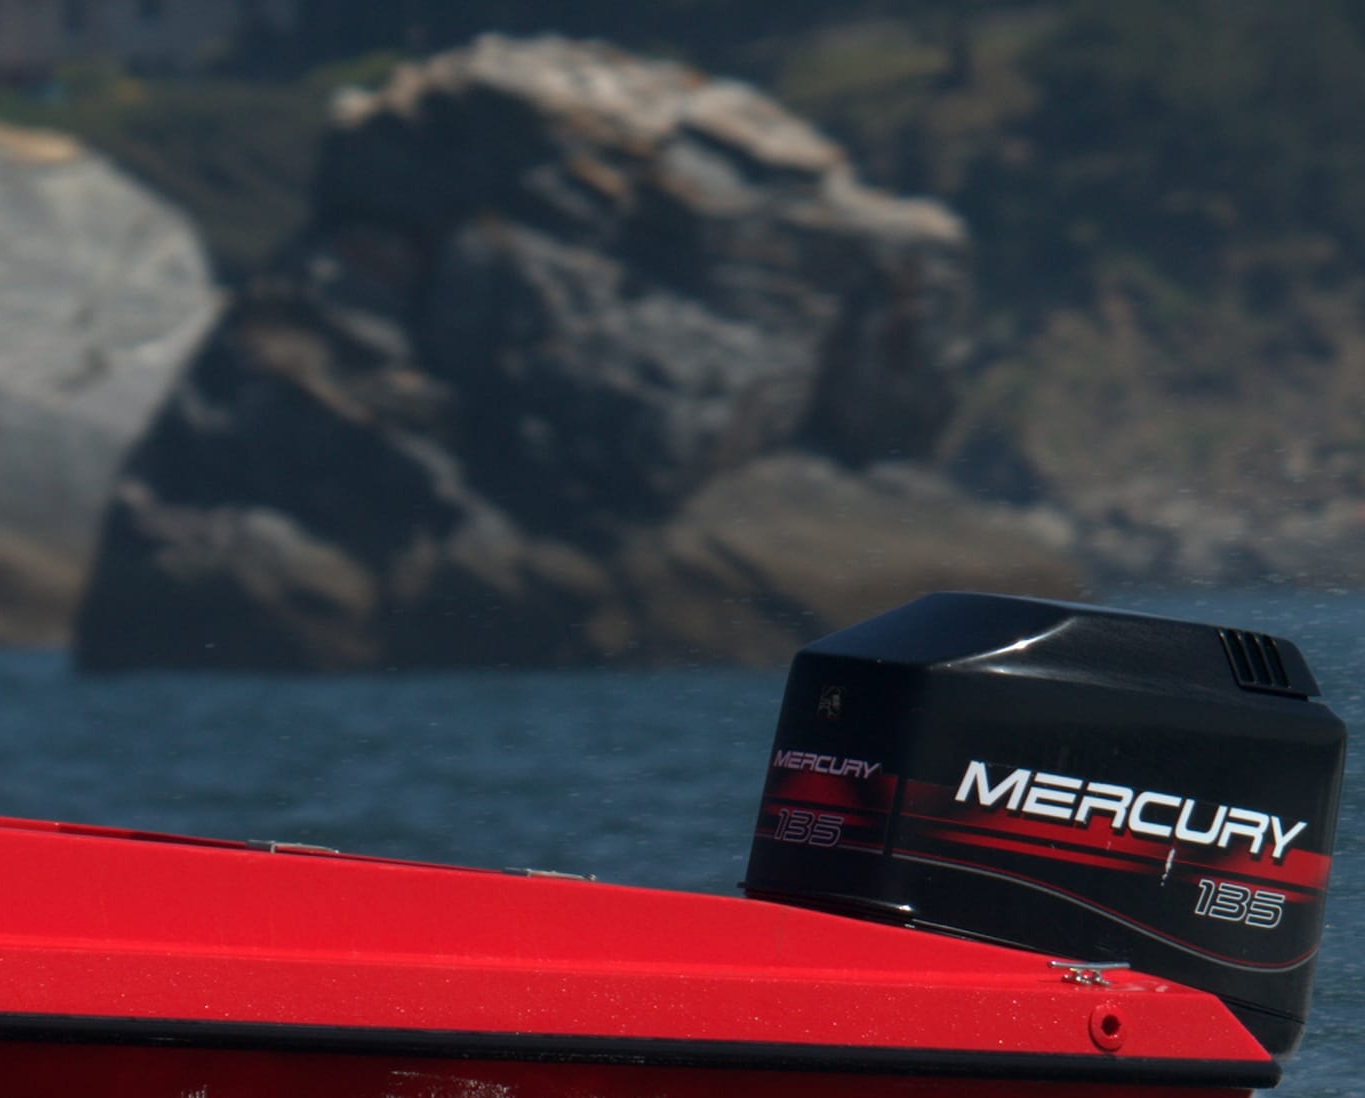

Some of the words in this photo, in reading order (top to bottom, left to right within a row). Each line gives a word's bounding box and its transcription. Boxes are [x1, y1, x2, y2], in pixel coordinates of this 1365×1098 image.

[773, 750, 881, 779] MERCURY
[774, 808, 844, 847] 135
[954, 760, 1307, 859] MERCURY
[1194, 878, 1286, 929] 135
